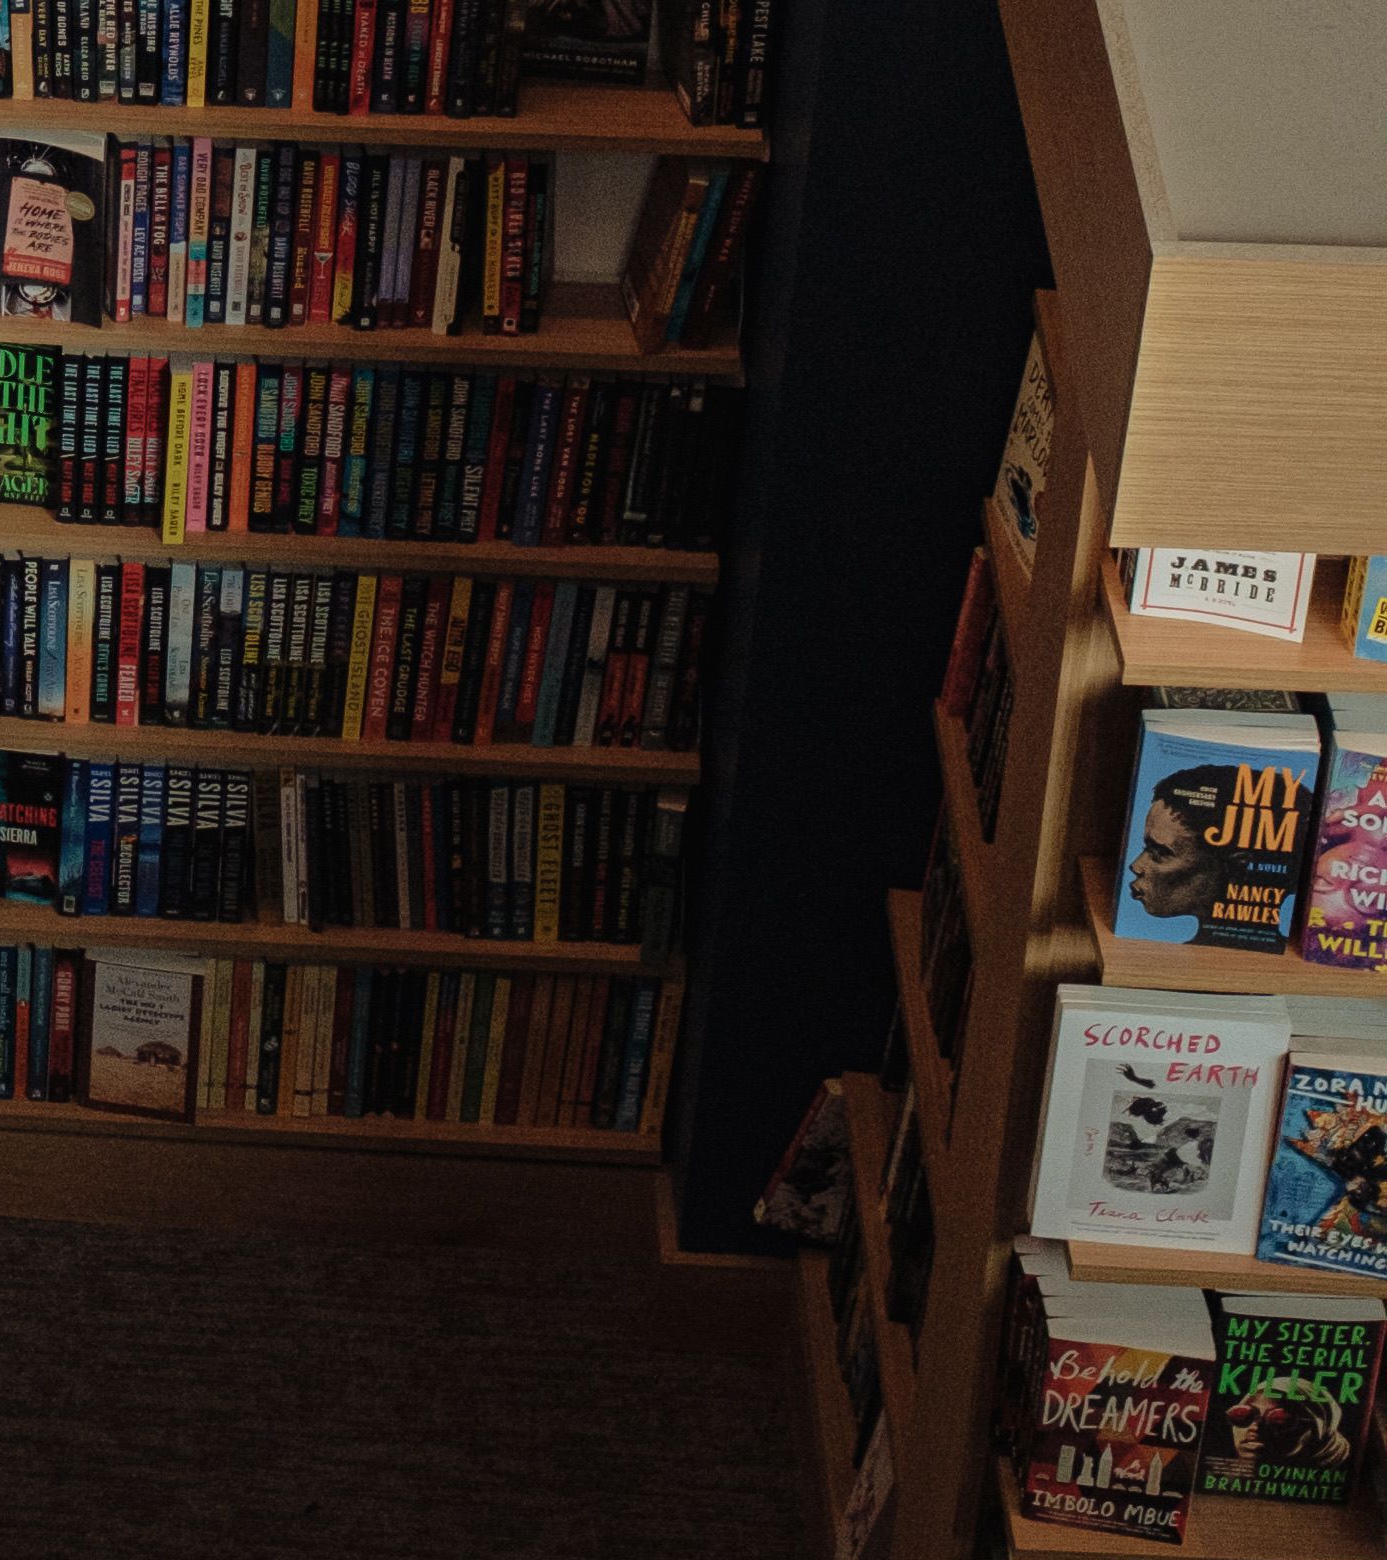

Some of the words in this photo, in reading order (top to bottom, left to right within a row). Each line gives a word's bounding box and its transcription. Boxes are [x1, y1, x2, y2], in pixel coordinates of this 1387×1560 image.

[1170, 556, 1278, 584] JAMES
[87, 778, 112, 823] SILVA
[1232, 762, 1307, 810] MY
[1203, 804, 1300, 854] JIM
[1226, 882, 1286, 906] NANCY
[1211, 900, 1282, 926] RAWLES
[1083, 1023, 1222, 1054] SCORCHED
[1165, 1061, 1262, 1089] EARTH
[1049, 1348, 1160, 1390] Behold
[1168, 1366, 1205, 1395] the
[1218, 1362, 1365, 1405] KILLER
[1041, 1387, 1201, 1444] DREAMERS
[1204, 1476, 1344, 1502] BRAITHWAITE
[1258, 1463, 1347, 1484] OYINKAN
